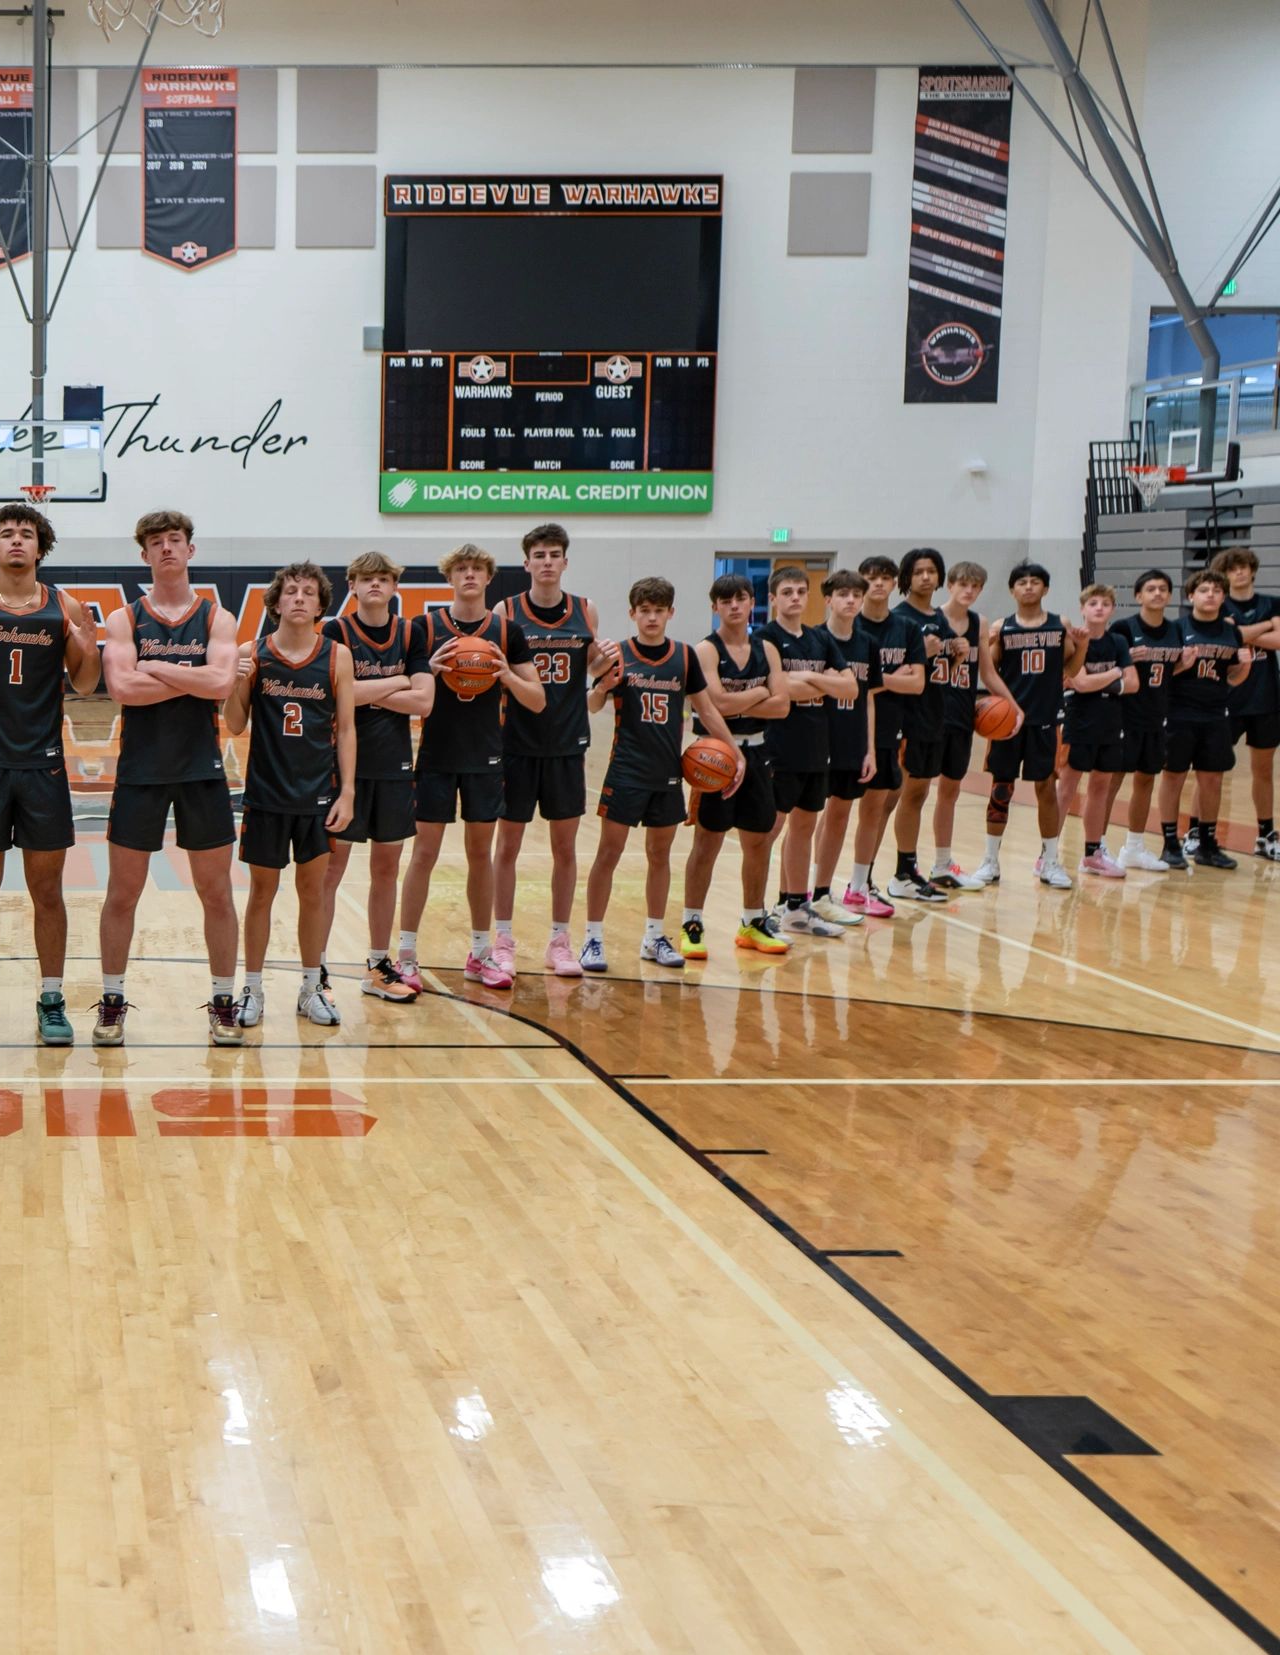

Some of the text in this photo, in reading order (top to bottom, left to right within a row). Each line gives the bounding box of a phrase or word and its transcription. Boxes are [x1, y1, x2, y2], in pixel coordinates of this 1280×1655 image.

[152, 73, 230, 82] RIDGEVUE
[920, 75, 1011, 92] SPORTSMANSHIP
[144, 82, 236, 92] WARHAWKS
[166, 95, 213, 105] SOFTBALL
[392, 183, 720, 206] RIDGEVUE WARHAWKS
[929, 327, 976, 345] WARHAWKS
[390, 358, 443, 368] PLYR FLS PTS
[656, 358, 709, 367] PLYR FLS PTS
[455, 386, 512, 399] WARHAWKS
[535, 392, 564, 402] PERIOD
[595, 386, 633, 399] GUEST
[99, 393, 309, 469] Thunder
[461, 428, 486, 438] FOULS
[494, 428, 515, 438] T.O.L.
[524, 428, 575, 438] PLAYER FOUL
[582, 428, 604, 438] T.O.L.
[611, 428, 636, 438] FOULS
[460, 460, 485, 470] SCORE
[534, 460, 561, 470] MATCH
[610, 460, 635, 470] SCORE
[423, 485, 708, 501] IDAHO CENTRAL CREDIT UNION
[1004, 630, 1063, 650] RIDGEVUE
[139, 638, 207, 657] Warhawks
[9, 648, 23, 685] 1
[534, 652, 571, 685] 23
[1021, 649, 1046, 675] 10
[1148, 662, 1165, 687] 3
[261, 678, 326, 700] Warhawks
[626, 673, 681, 692] Warhawks
[639, 692, 669, 725] 15
[282, 702, 303, 737] 2
